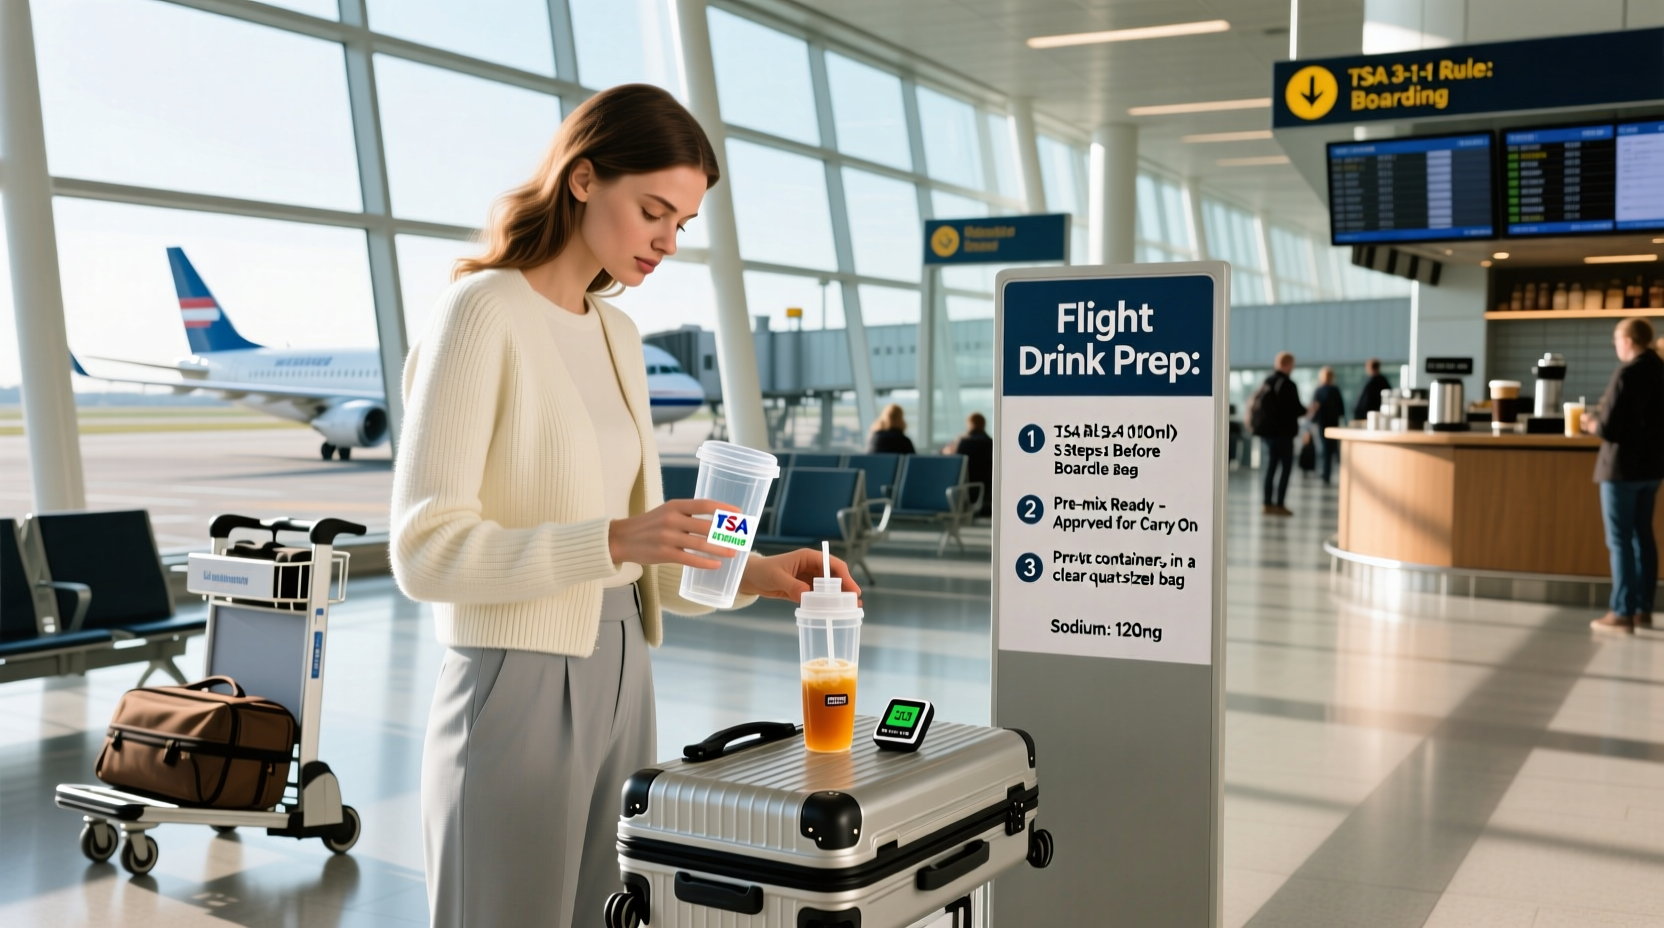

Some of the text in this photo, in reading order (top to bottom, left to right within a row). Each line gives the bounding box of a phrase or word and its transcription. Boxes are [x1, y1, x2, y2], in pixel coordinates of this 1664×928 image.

[1348, 66, 1389, 87] TSA
[1438, 58, 1494, 81] Rule:
[1350, 87, 1449, 111] Boarding
[1057, 300, 1154, 342] Flight
[1018, 343, 1201, 384] Drink Prep:
[1027, 430, 1035, 448] 1
[1053, 424, 1081, 439] TSA
[1113, 443, 1161, 458] Before
[1024, 499, 1036, 518] 2
[1053, 496, 1108, 511] Pre-mix
[1110, 498, 1155, 515] Ready
[716, 513, 749, 536] TSA
[1116, 515, 1137, 531] for
[1177, 517, 1199, 533] On
[1023, 558, 1036, 577] 3
[1170, 552, 1183, 568] in
[1187, 556, 1197, 569] a
[1052, 567, 1087, 583] clear
[1159, 571, 1186, 590] bag
[1050, 618, 1111, 637] Sodium:
